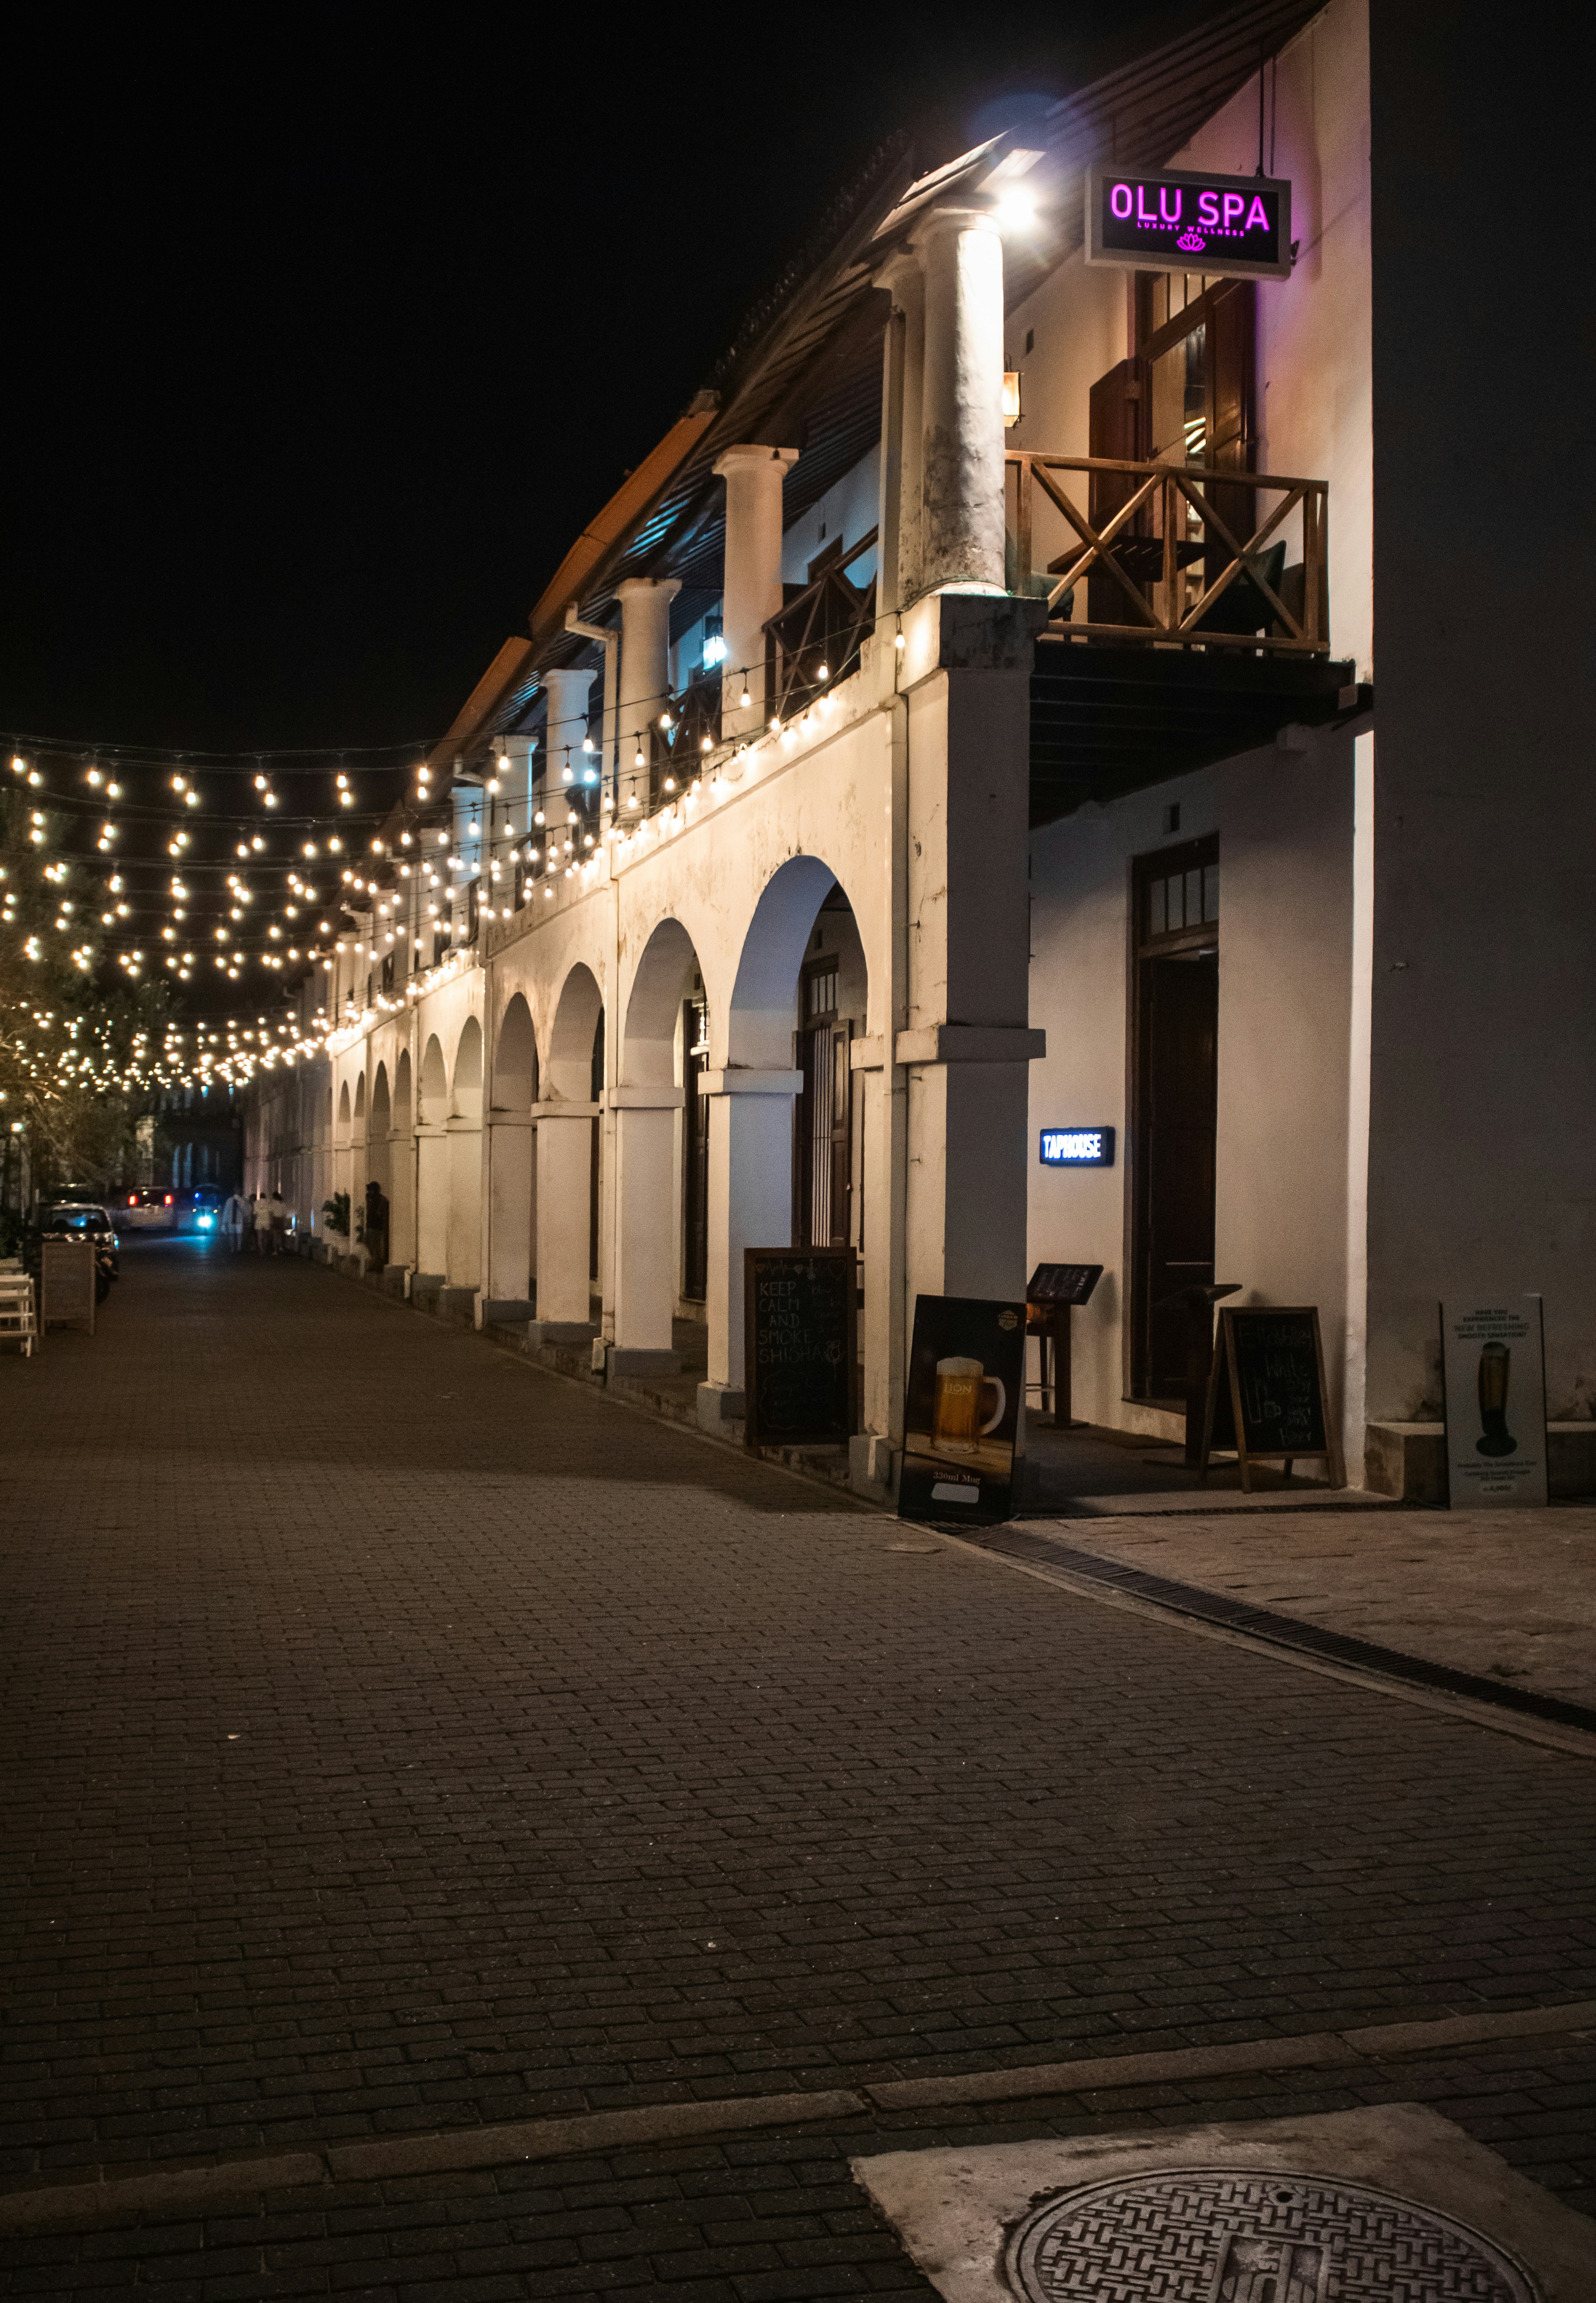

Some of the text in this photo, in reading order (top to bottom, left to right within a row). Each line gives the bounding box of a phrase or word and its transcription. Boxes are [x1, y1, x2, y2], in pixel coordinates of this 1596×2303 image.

[1111, 183, 1270, 231] OLU SPA
[1137, 221, 1244, 237] LUXURY WELLNESS
[1043, 1133, 1102, 1158] TAPHOUSE
[760, 1281, 797, 1297] KEEP
[759, 1298, 800, 1312] CALM
[769, 1313, 800, 1328] AND
[758, 1328, 814, 1345] SMOKE
[758, 1343, 824, 1364] SHISHA
[944, 1383, 972, 1393] LION
[933, 1471, 981, 1486] 330ml Mug
